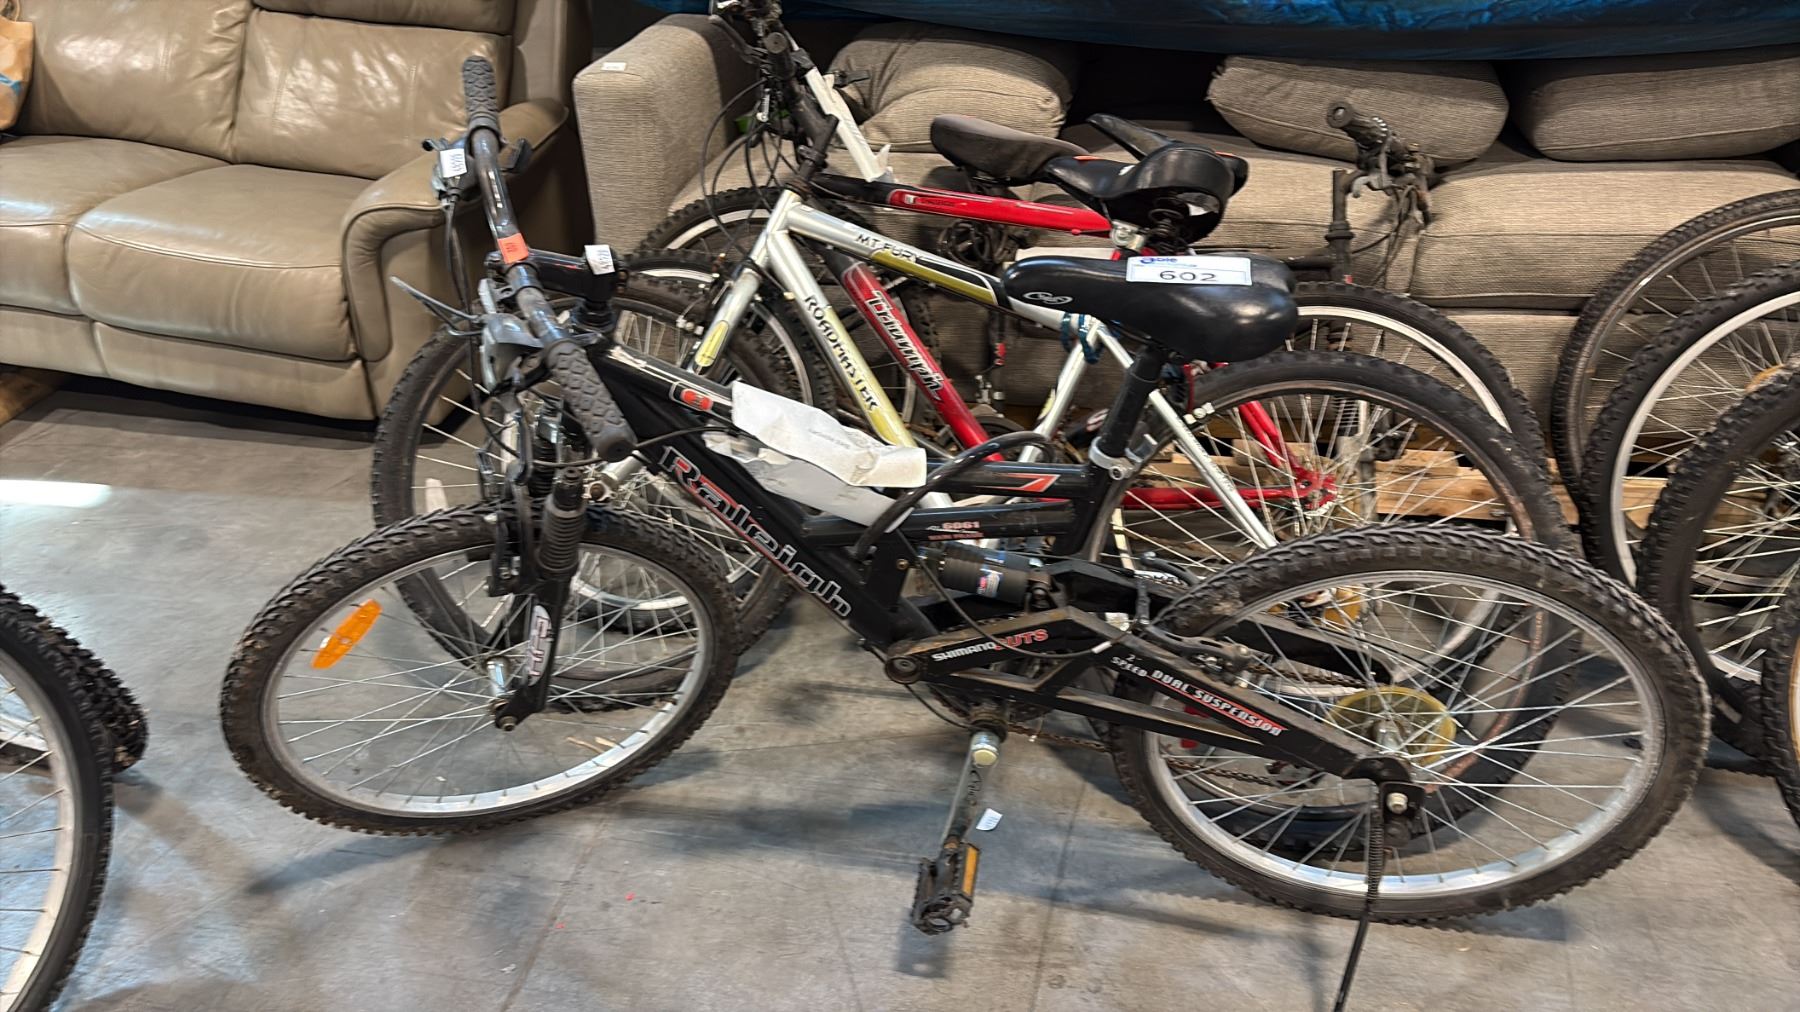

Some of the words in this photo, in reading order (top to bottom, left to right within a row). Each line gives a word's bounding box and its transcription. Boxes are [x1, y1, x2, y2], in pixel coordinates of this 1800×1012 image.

[856, 234, 880, 248] MT
[1159, 270, 1218, 282] 602
[805, 296, 878, 411] ROADMASTER
[865, 289, 944, 401] Triumph
[658, 446, 852, 617] Raleigh
[931, 641, 996, 661] SHIMANO
[1111, 656, 1148, 677] SPEED
[1151, 670, 1190, 694] DUAL
[1195, 688, 1283, 736] SUSPENSION
